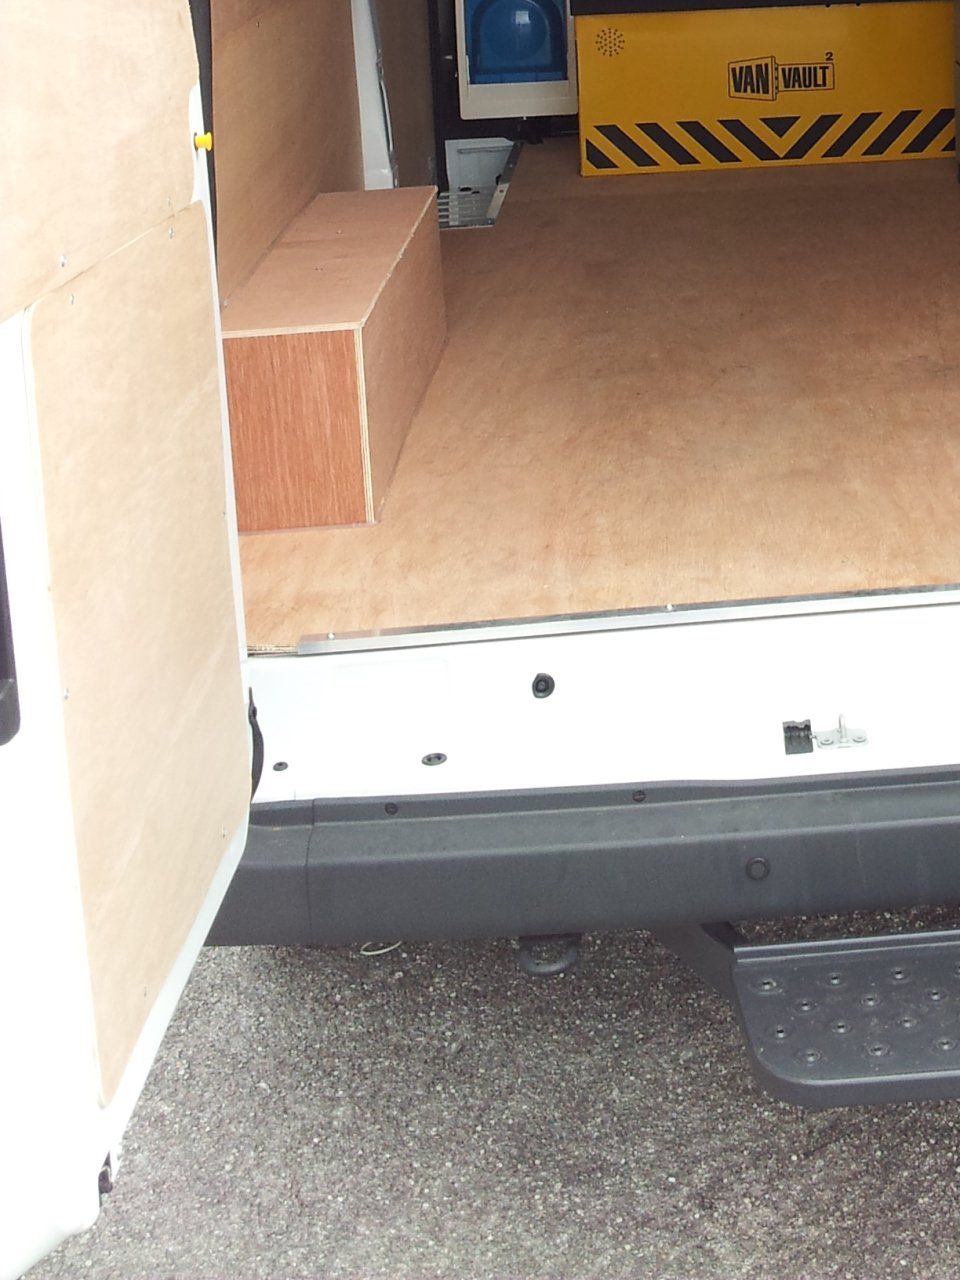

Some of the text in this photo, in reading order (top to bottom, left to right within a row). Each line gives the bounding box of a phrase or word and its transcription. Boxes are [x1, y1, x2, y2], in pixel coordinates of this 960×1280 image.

[825, 52, 834, 61] 2
[731, 63, 830, 95] VAN VAULT
